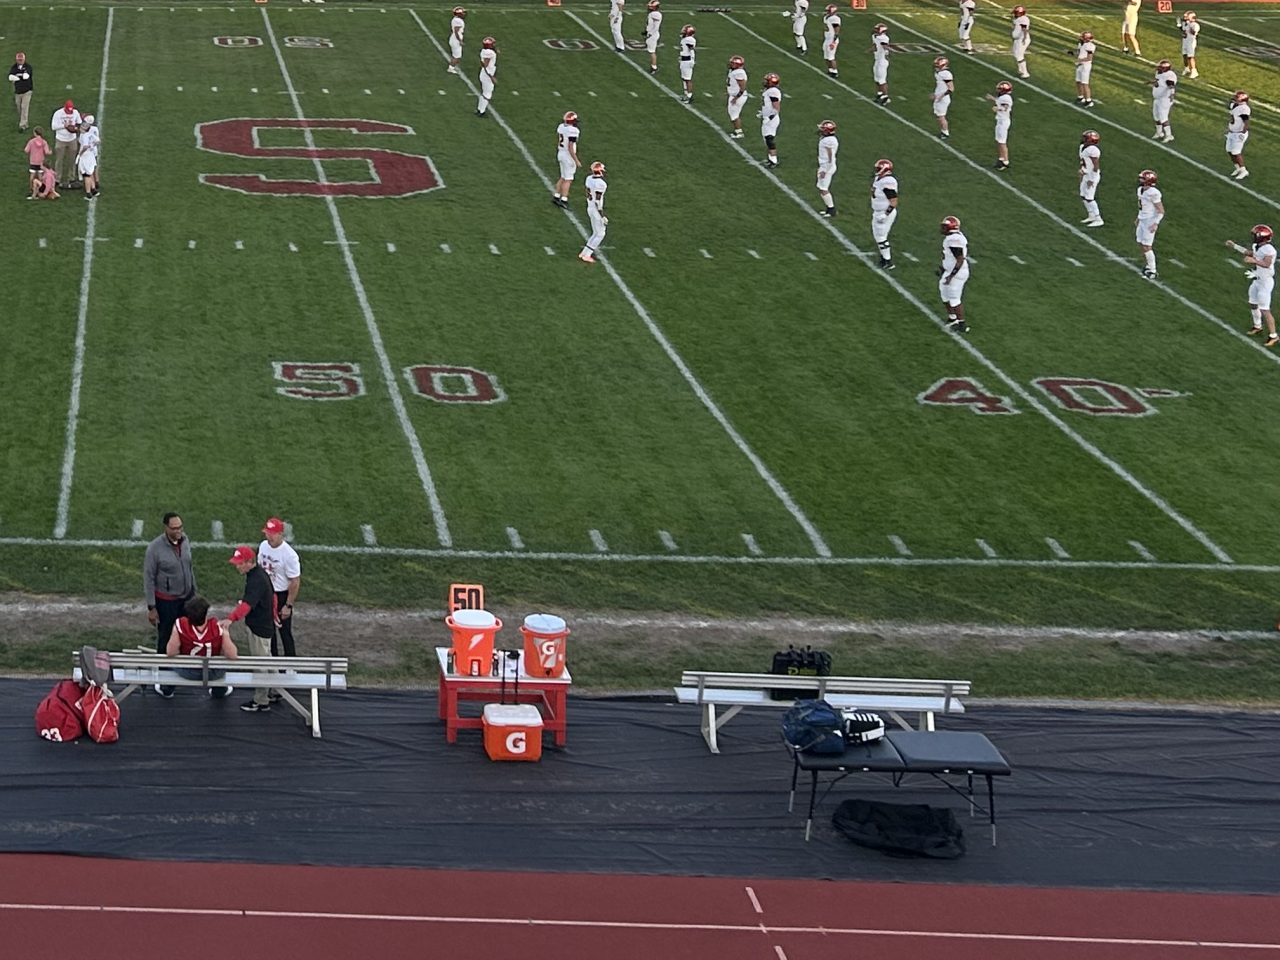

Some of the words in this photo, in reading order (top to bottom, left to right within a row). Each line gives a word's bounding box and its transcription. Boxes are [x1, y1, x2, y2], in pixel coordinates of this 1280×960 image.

[1160, 2, 1170, 11] 20
[271, 361, 508, 404] 50
[916, 377, 1159, 417] 40
[453, 587, 482, 610] 50
[542, 641, 555, 655] G
[505, 732, 527, 754] G
